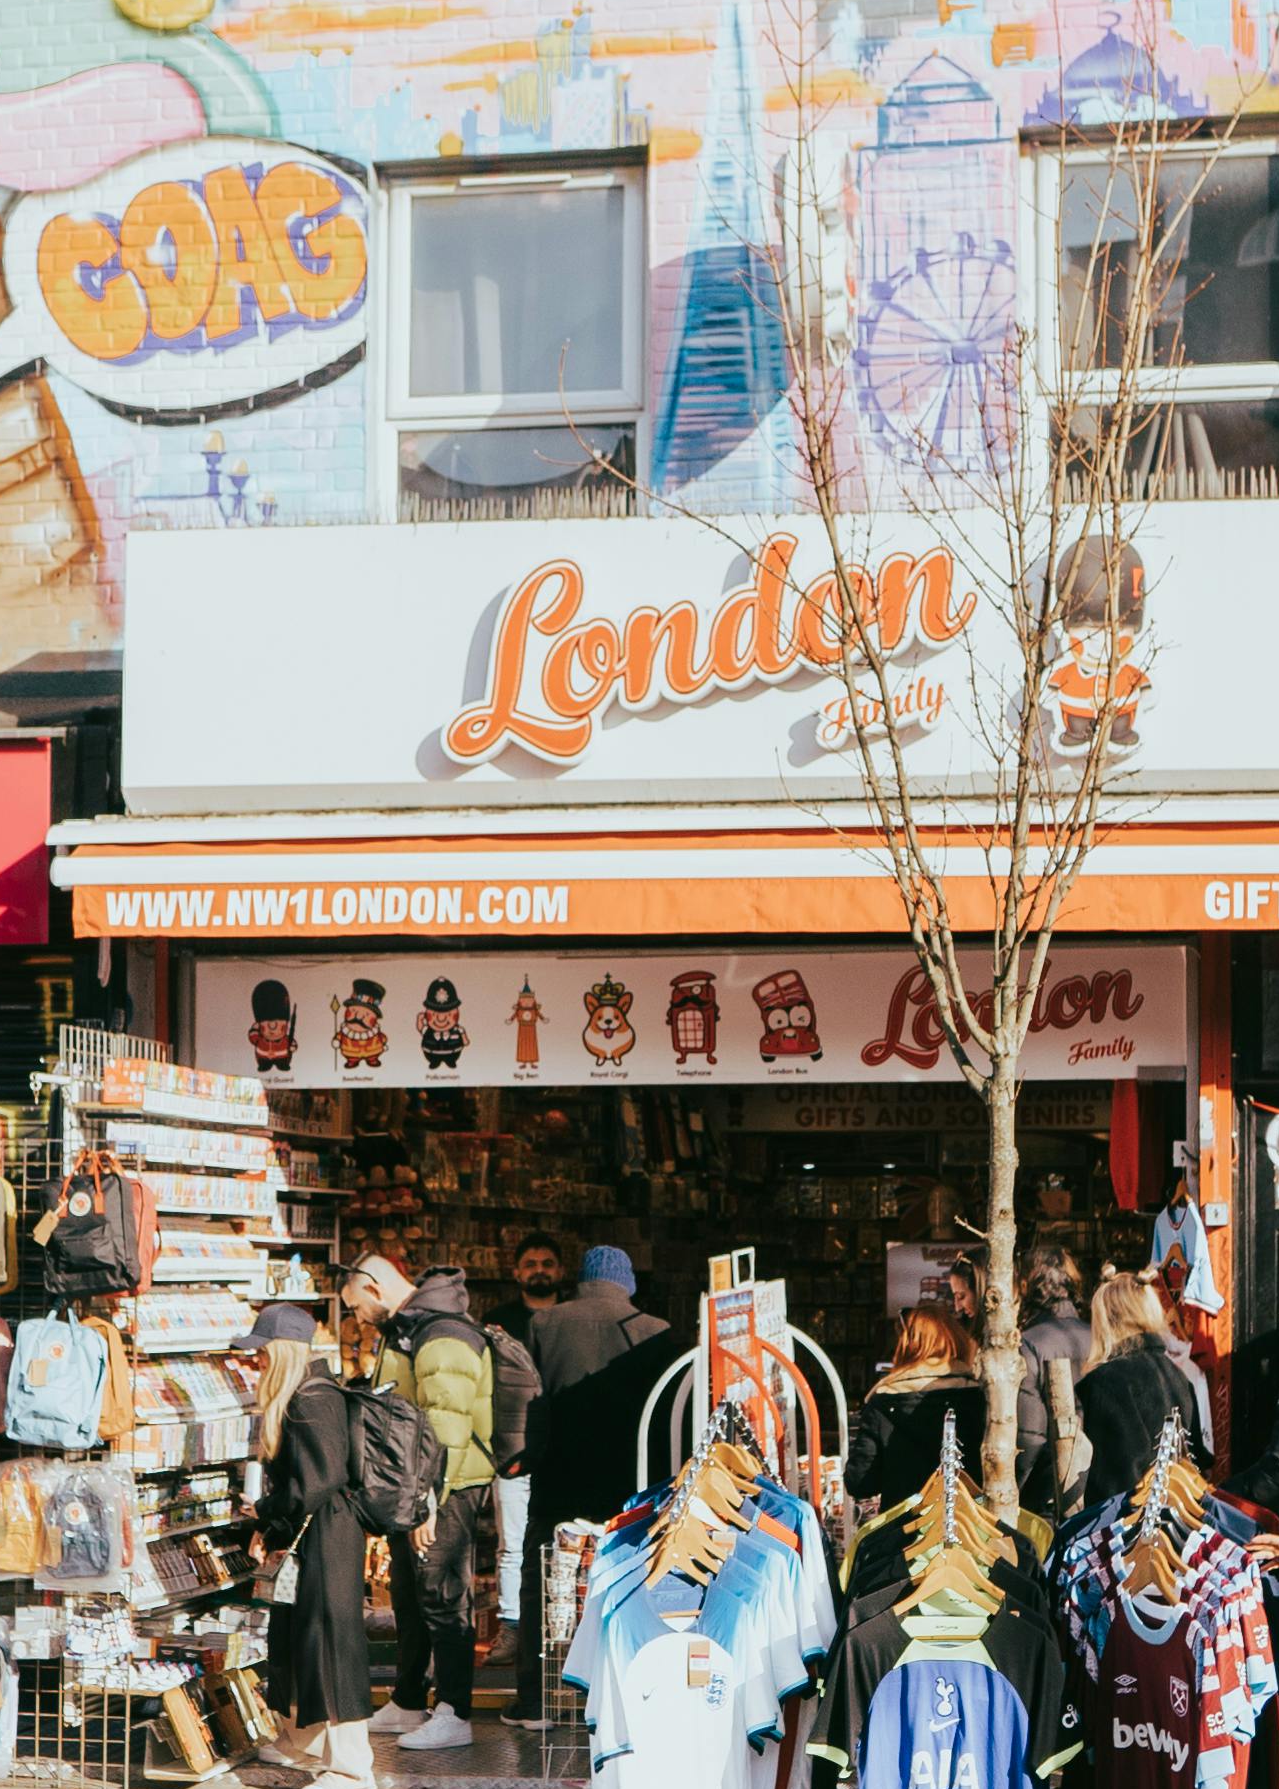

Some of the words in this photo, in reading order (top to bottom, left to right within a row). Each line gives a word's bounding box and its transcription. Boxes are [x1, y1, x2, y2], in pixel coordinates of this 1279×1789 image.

[37, 160, 369, 366] COAG
[448, 531, 978, 758] London
[106, 885, 570, 928] WWW.NW1LONDON.COM
[1067, 1035, 1136, 1066] Family
[897, 1082, 980, 1103] LOND
[795, 1106, 866, 1129] GIFTS
[874, 1105, 935, 1128] AND
